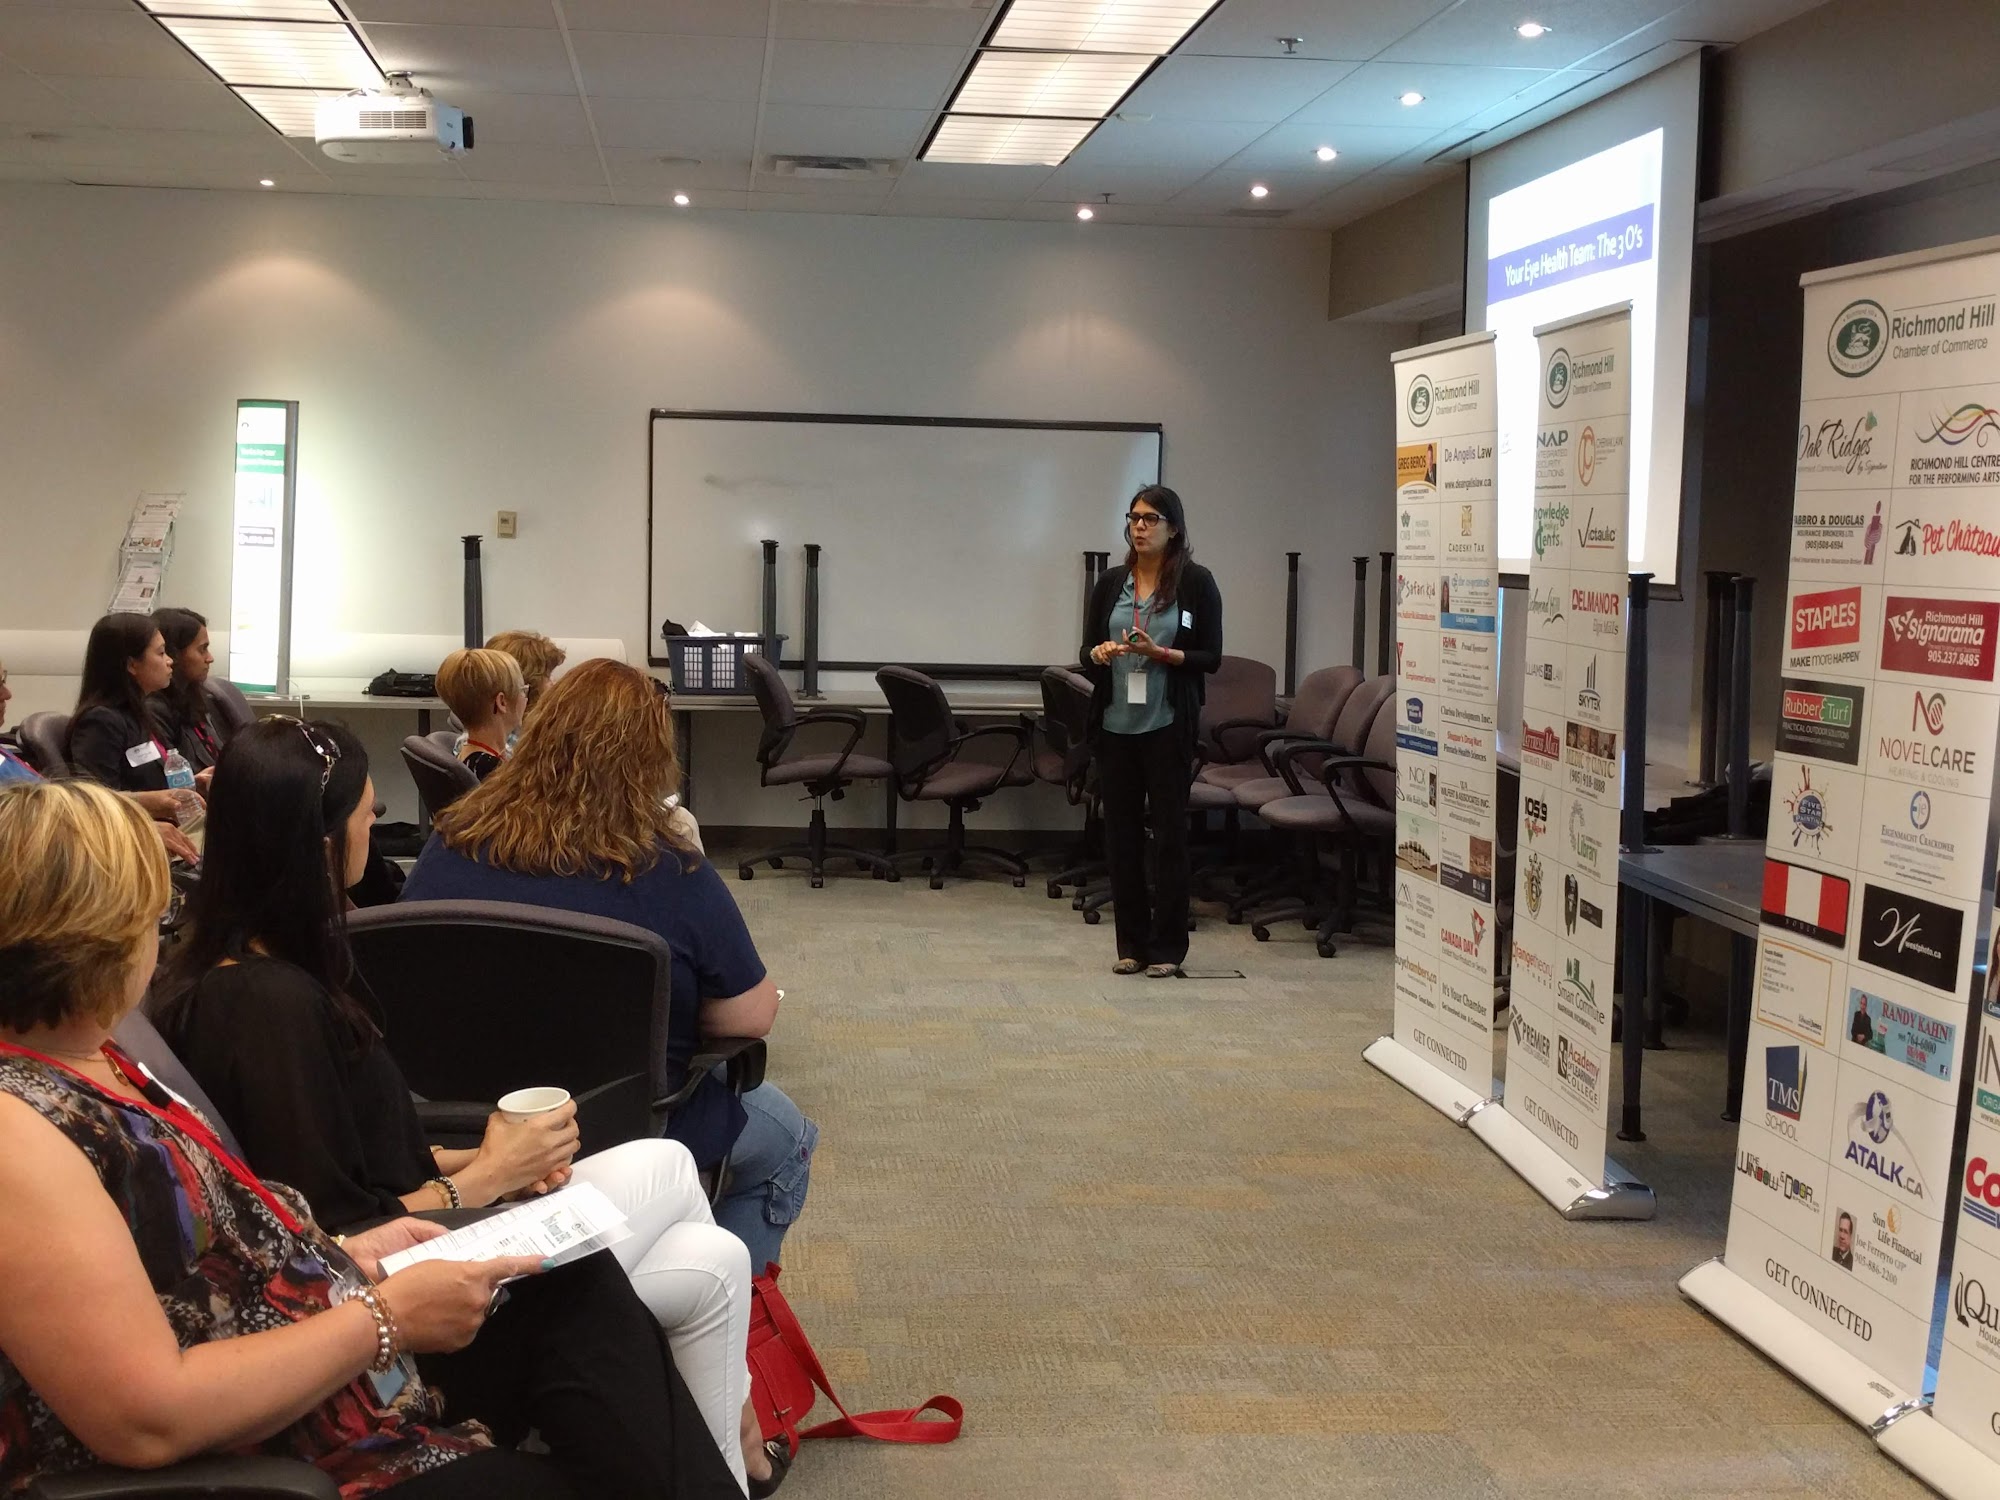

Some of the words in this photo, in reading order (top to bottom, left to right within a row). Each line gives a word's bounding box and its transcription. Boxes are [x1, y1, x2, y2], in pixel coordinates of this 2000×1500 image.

[1505, 264, 1524, 287] Your
[1524, 258, 1540, 287] Eye
[1540, 245, 1568, 276] Health
[1568, 243, 1596, 267] Team:
[1596, 232, 1616, 258] The
[1616, 238, 1624, 260] 3
[1624, 225, 1643, 250] O's
[1891, 307, 1966, 340] Richmond
[1969, 303, 1996, 329] Hill
[1893, 344, 1930, 360] Chamber
[1931, 341, 1941, 356] of
[1942, 336, 1988, 354] Commerce
[1572, 360, 1603, 380] Richmond
[1604, 354, 1614, 374] Hill
[1435, 384, 1467, 402] Richmond
[1468, 380, 1480, 396] Hill
[1458, 402, 1478, 412] Commerce
[1444, 448, 1452, 462] De
[1452, 446, 1476, 464] Angelis
[1477, 444, 1492, 460] Law
[1822, 416, 1873, 475] Ridges
[1910, 456, 1952, 471] RICHMOND
[1954, 456, 1969, 470] HILL
[1970, 454, 2000, 469] CENTRE
[1909, 474, 1922, 485] FOR
[1923, 474, 1936, 484] THE
[1936, 472, 1981, 484] PERFORMING
[1982, 472, 2000, 483] ARTS
[1820, 515, 1826, 525] &
[1828, 514, 1865, 526] DOUGLAS
[1474, 542, 1485, 552] TAX
[1922, 523, 1945, 556] Pet
[1406, 580, 1424, 598] Safari
[1426, 581, 1436, 600] kid
[1572, 589, 1620, 616] DELMANOR
[1795, 602, 1857, 633] STAPLES
[1925, 611, 1967, 625] Richmond
[1968, 614, 1984, 626] Hill
[1907, 619, 1985, 646] Signarama
[1790, 656, 1811, 668] MAKE
[1811, 654, 1832, 666] more
[1832, 652, 1860, 664] HAPPEN
[1927, 650, 1980, 667] 905.237.8485
[1578, 694, 1601, 712] SKYTEK
[1784, 696, 1820, 716] Rubber
[1828, 703, 1849, 721] Turf
[1481, 714, 1493, 724] Inc.
[1879, 736, 1976, 775] NOVELCARE
[1440, 928, 1463, 951] CANADA
[1442, 982, 1450, 997] It's
[1450, 986, 1462, 1003] Your
[1462, 994, 1487, 1017] Chamber
[1558, 981, 1575, 1006] Smart
[1576, 991, 1605, 1025] Commute
[1882, 1001, 1917, 1029] RANDY
[1918, 1015, 1948, 1041] KAHN
[1414, 1028, 1426, 1045] GET
[1426, 1037, 1468, 1071] CONNECTED
[1522, 1022, 1551, 1058] PREMIER
[1568, 1043, 1600, 1083] Academy
[1566, 1073, 1598, 1105] COLLEGE
[1572, 1064, 1596, 1091] LEARNING
[1768, 1078, 1800, 1113] TMS
[1524, 1095, 1536, 1117] GET
[1537, 1104, 1579, 1150] CONNECTED
[1764, 1113, 1799, 1142] SCHOOL
[1872, 1212, 1886, 1229] Sun
[1856, 1234, 1866, 1250] Joe
[1878, 1230, 1891, 1247] Life
[1891, 1232, 1922, 1266] Financial
[1765, 1258, 1790, 1288] GET
[1790, 1275, 1872, 1342] CONNECTED
